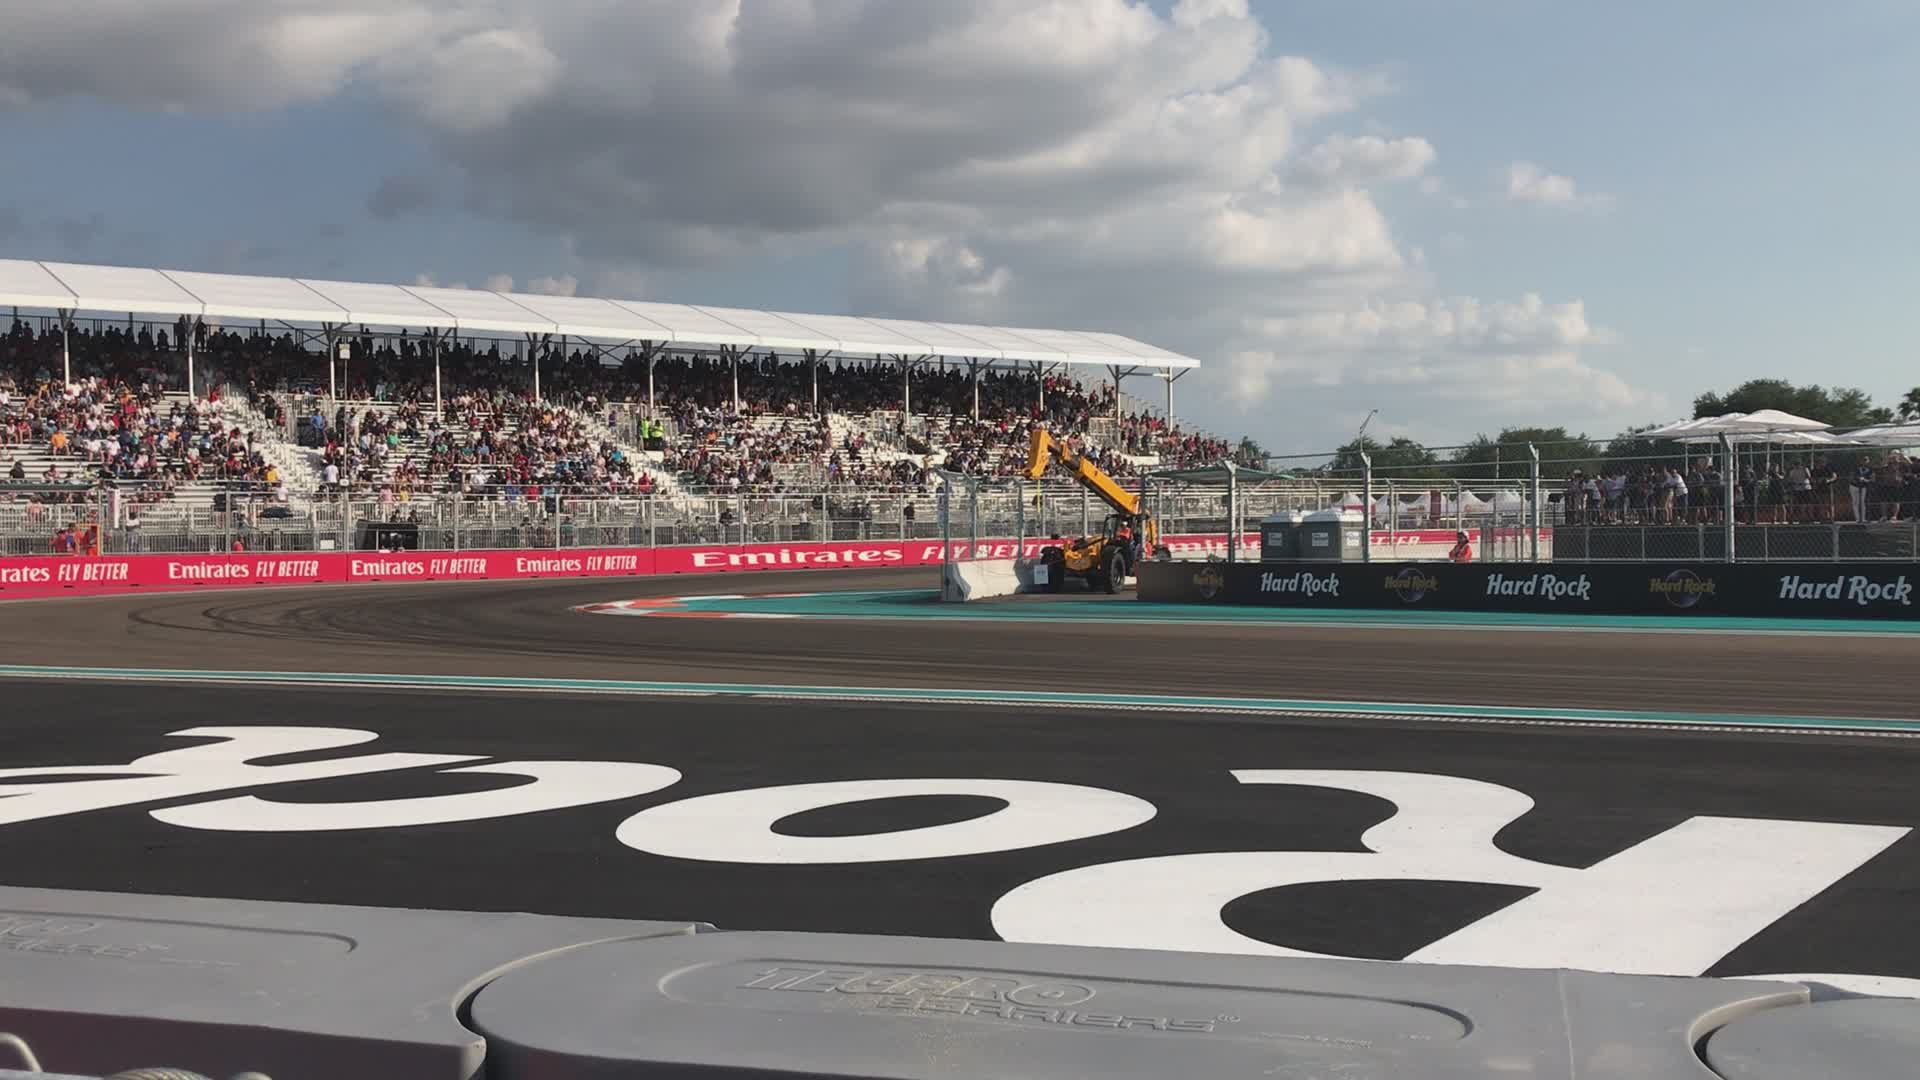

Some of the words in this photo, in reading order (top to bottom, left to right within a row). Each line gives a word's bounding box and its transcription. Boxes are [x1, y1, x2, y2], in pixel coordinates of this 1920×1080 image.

[351, 558, 425, 576] Emirates
[430, 558, 449, 575] FLY
[450, 557, 487, 574] BETTER
[516, 556, 582, 573] Emirates
[586, 556, 604, 571] FLY
[604, 555, 637, 571] BETTER
[692, 548, 904, 568] Emirates
[57, 563, 81, 581] FLY
[83, 562, 129, 580] BETTER
[168, 561, 250, 579] Emirates
[255, 560, 276, 577] FLY
[278, 559, 319, 577] BETTER
[1261, 572, 1300, 592] Hard
[1301, 572, 1339, 596] Rock
[1486, 573, 1537, 595] Hard
[1540, 574, 1591, 600] Rock
[1779, 575, 1845, 600] Hard
[1847, 575, 1913, 606] Rock
